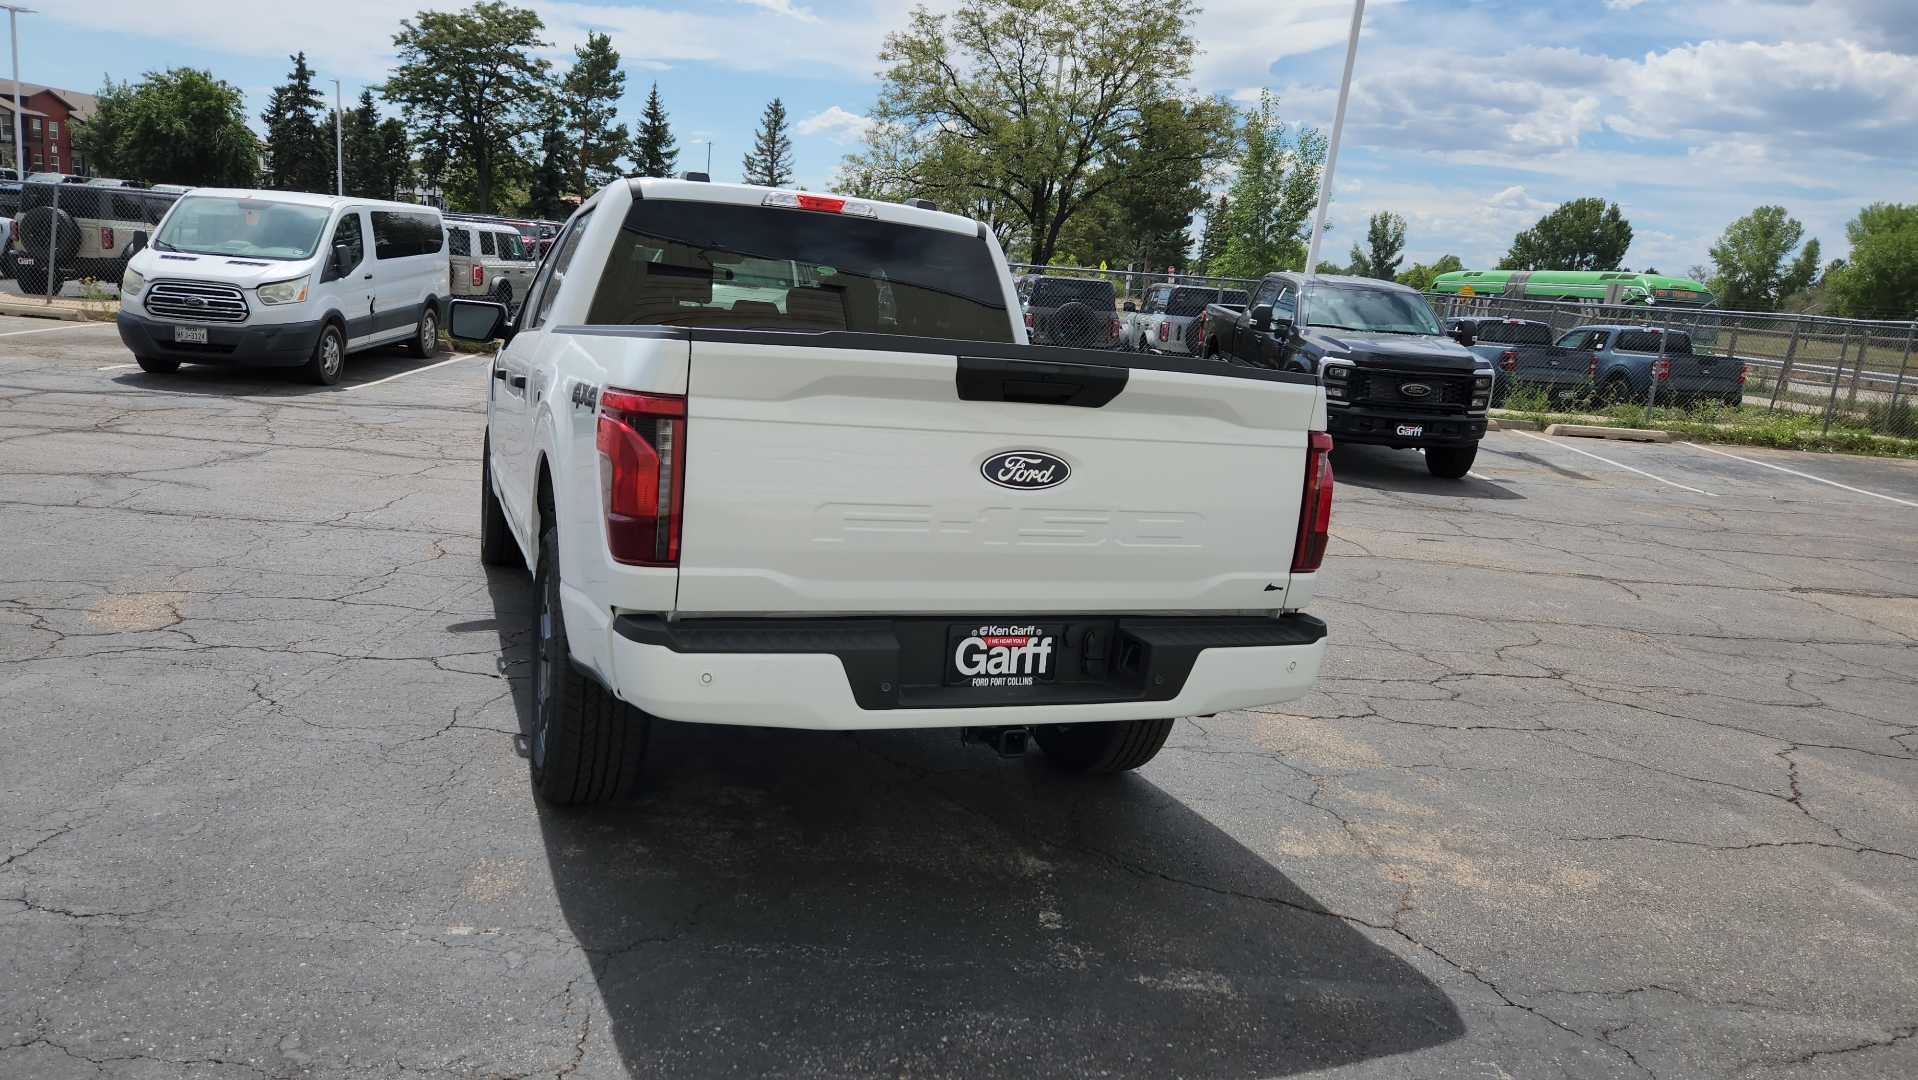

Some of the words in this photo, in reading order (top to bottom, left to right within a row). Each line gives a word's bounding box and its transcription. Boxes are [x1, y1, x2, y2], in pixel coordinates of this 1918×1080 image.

[1672, 290, 1698, 299] DOWNTOWN
[1396, 425, 1423, 437] Garff
[997, 456, 1056, 483] Ford
[812, 502, 1206, 548] F-150
[988, 626, 1009, 635] Ken
[1009, 625, 1035, 636] Garff
[955, 637, 1053, 676] Garff
[972, 677, 989, 687] FORD
[990, 677, 1007, 687] FORT
[1007, 676, 1033, 686] COLLINS
